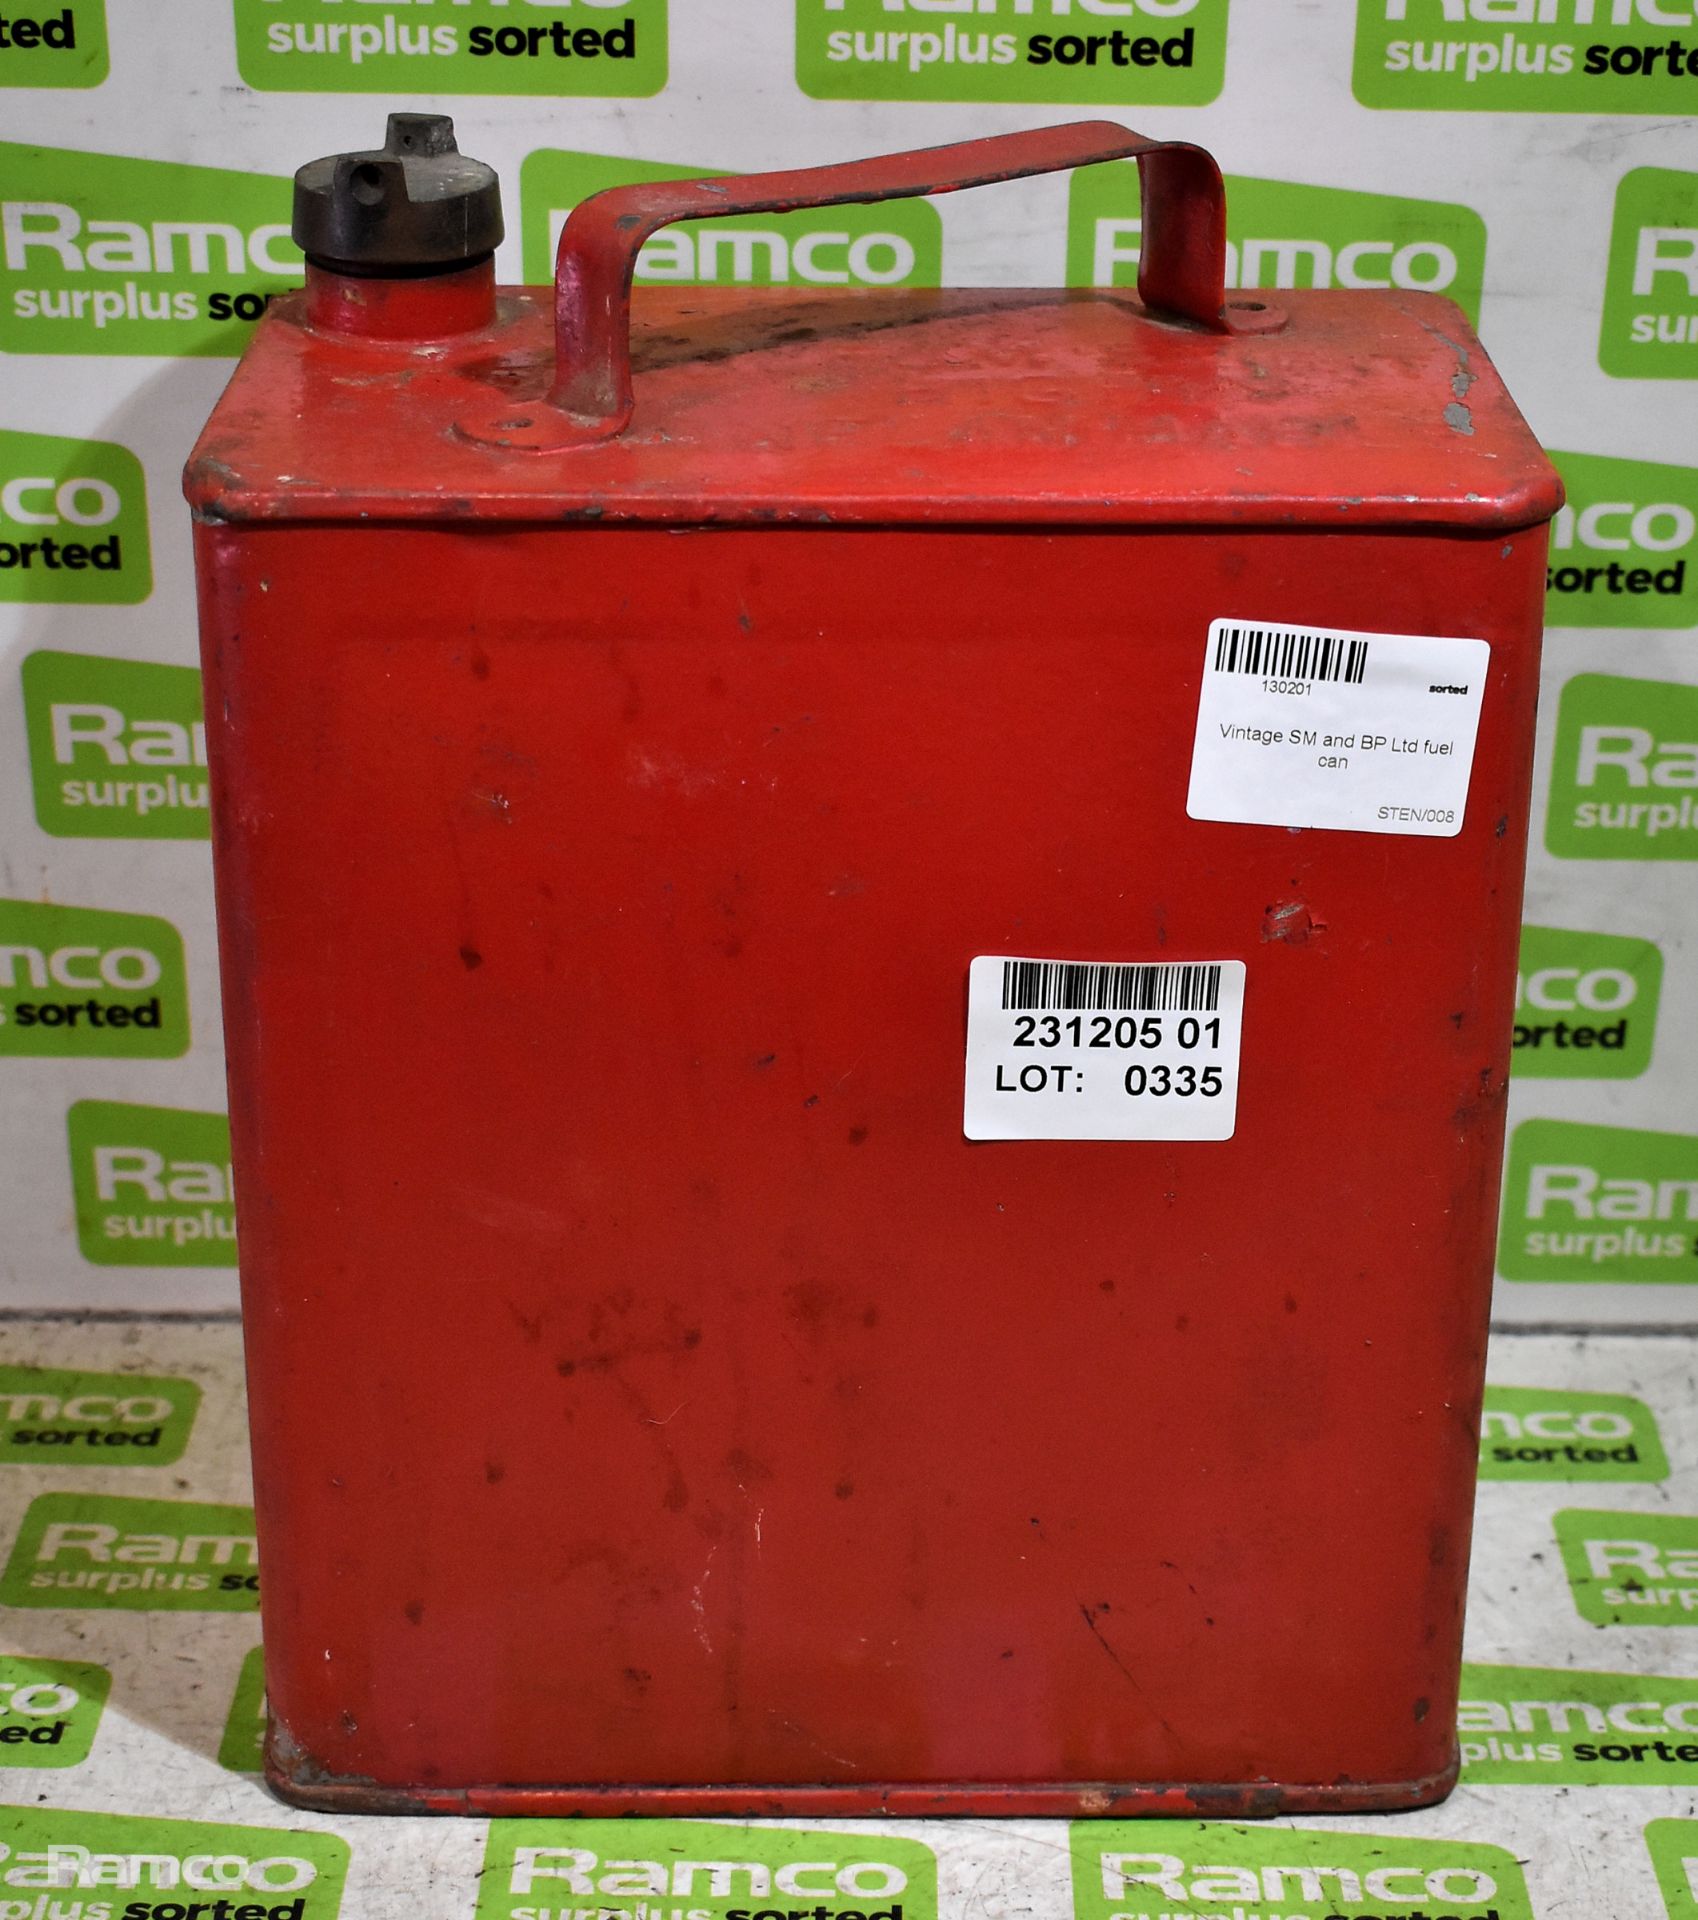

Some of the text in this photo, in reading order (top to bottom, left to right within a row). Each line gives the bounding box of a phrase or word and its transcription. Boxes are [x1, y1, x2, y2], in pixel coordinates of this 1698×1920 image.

[268, 14, 636, 64] surplus sorted
[827, 23, 1195, 73] surplus sorted
[1385, 33, 1576, 82] surplus
[548, 208, 915, 285] amco
[14, 281, 199, 329] surplus
[1261, 680, 1312, 696] 130201
[1429, 684, 1468, 695] sorted
[51, 703, 209, 766] Ra
[1219, 723, 1454, 756] Vintage SM and BP Ltd fuel
[1317, 755, 1349, 769] can
[1377, 806, 1455, 823] STEN/008
[15, 998, 162, 1029] sorted
[1013, 1016, 1221, 1049] 231205 01
[996, 1065, 1223, 1097] LOT: 0335
[94, 1146, 235, 1202] Ra
[1525, 1226, 1685, 1263] surplus
[11, 1427, 162, 1447] sorted
[1492, 1444, 1639, 1463] sorted
[30, 1567, 211, 1595] surplus
[510, 1847, 908, 1898] Ramco
[1100, 1852, 1497, 1903] Ramco
[124, 1898, 306, 1920] sorted
